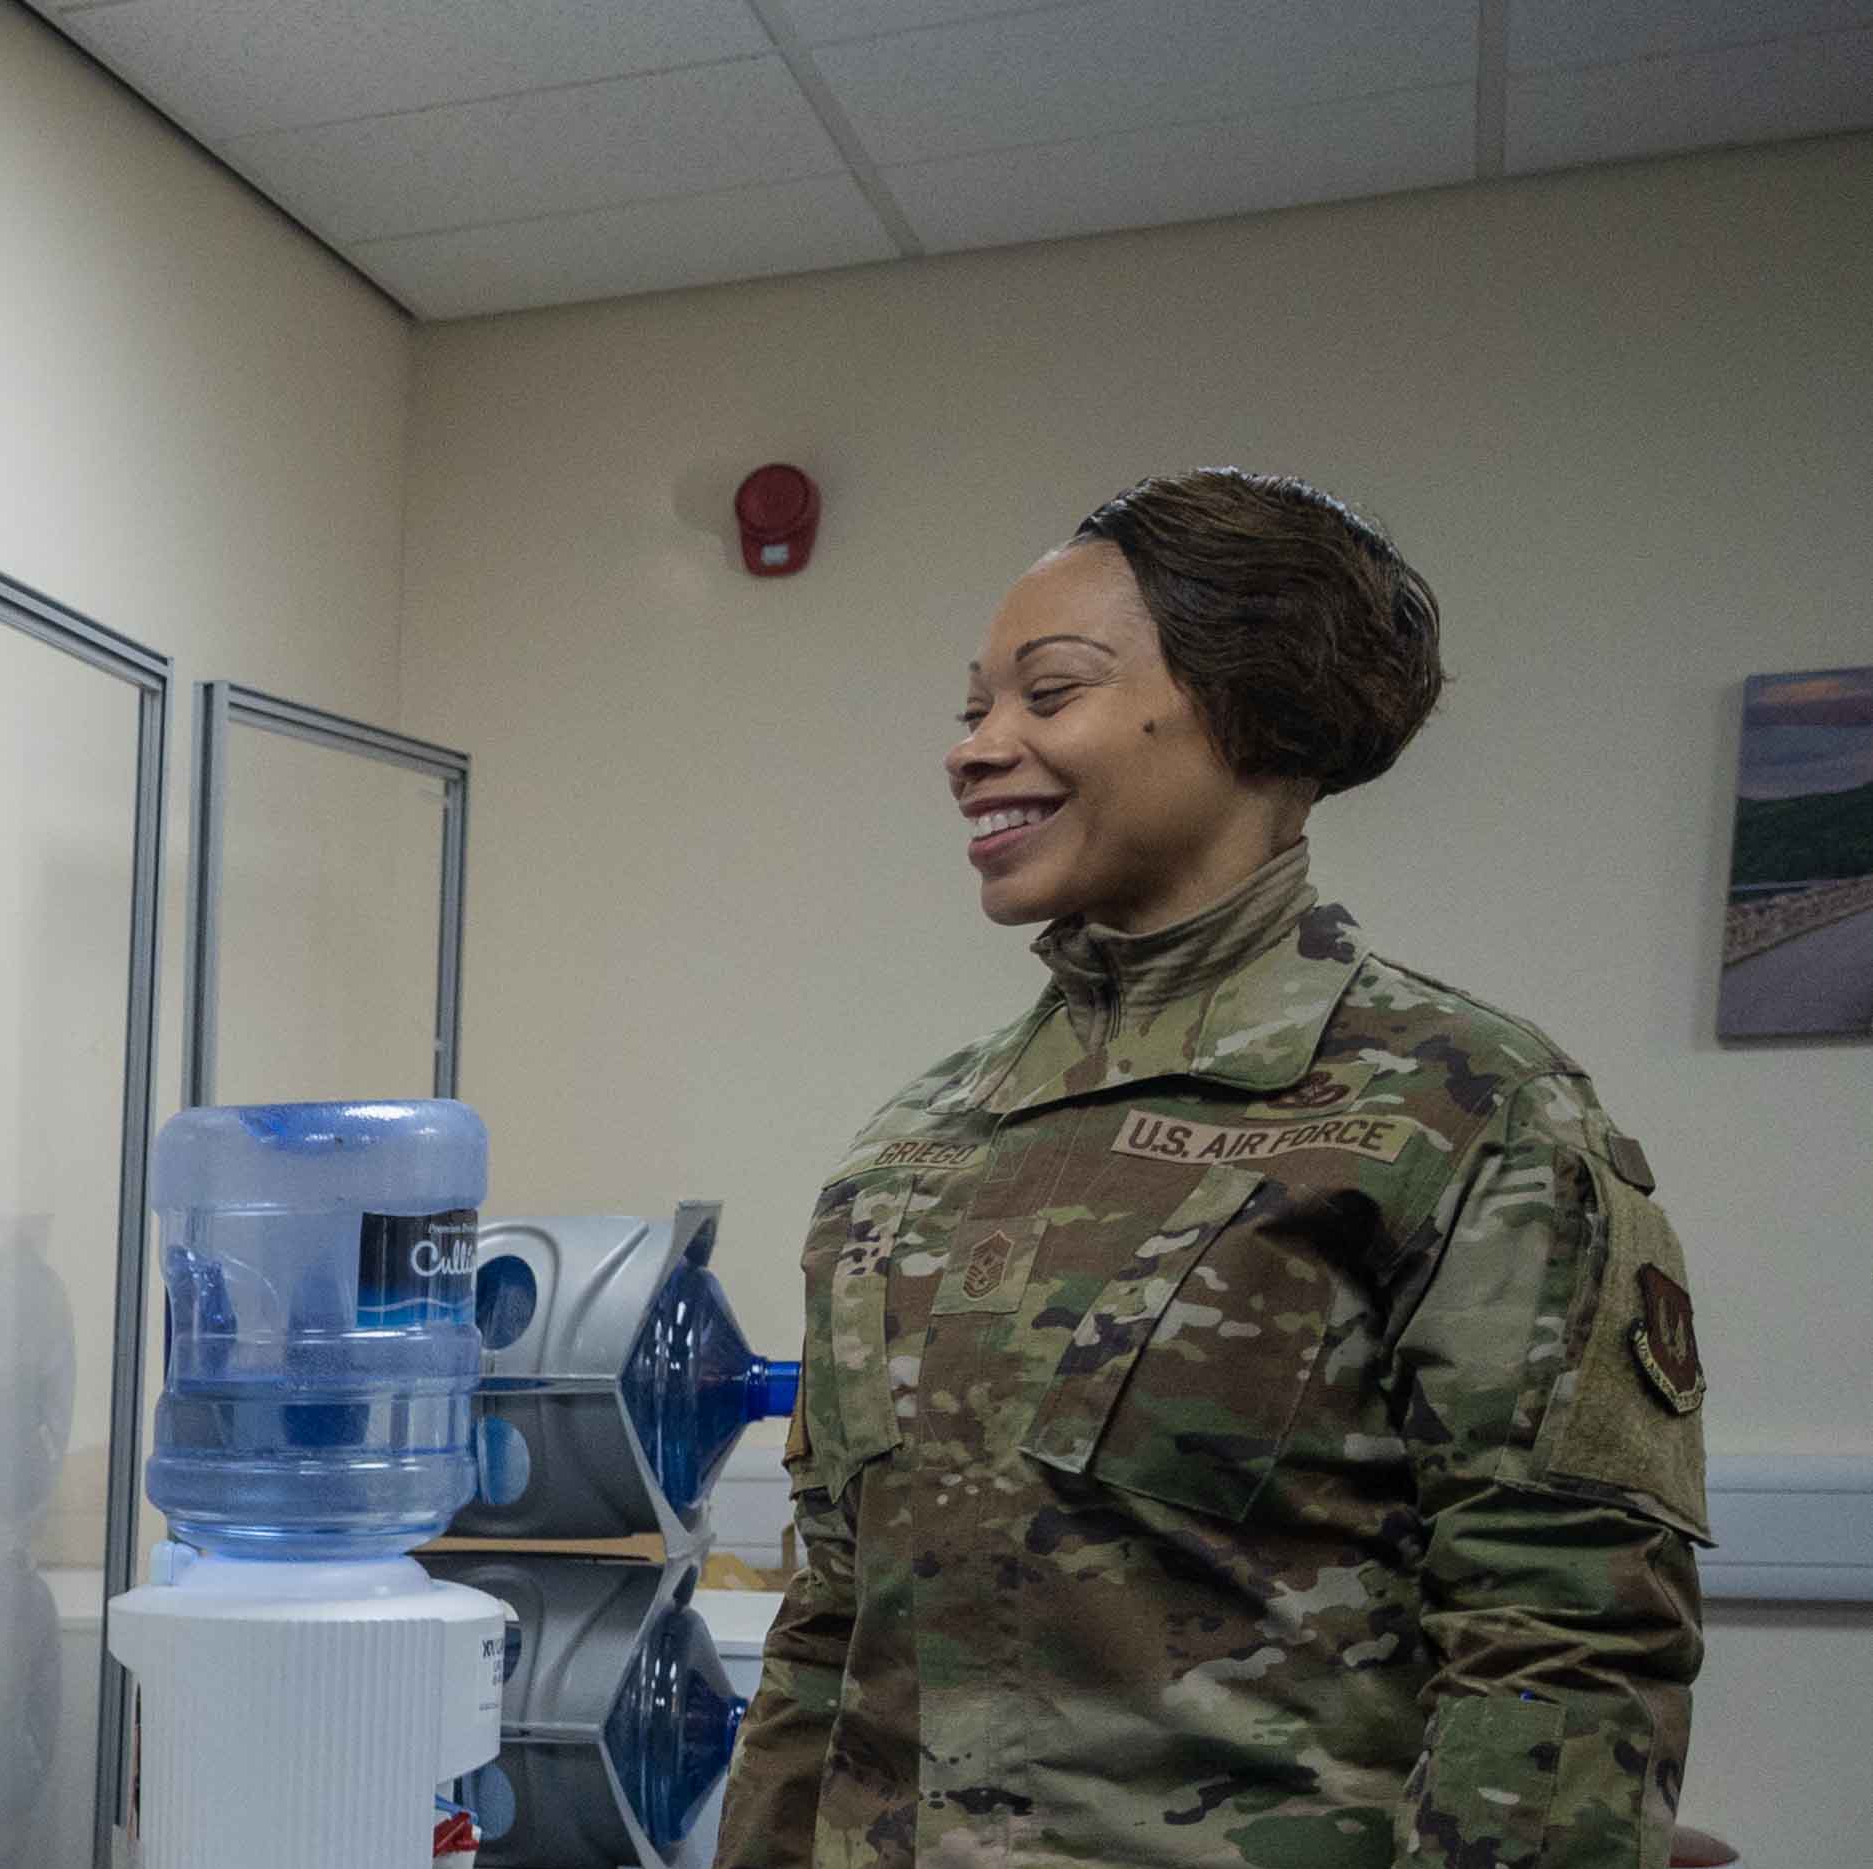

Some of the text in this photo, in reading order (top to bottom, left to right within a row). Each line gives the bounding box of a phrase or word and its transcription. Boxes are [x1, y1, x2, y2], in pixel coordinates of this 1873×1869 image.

[1128, 1117, 1397, 1159] U.S. AIR FORCE
